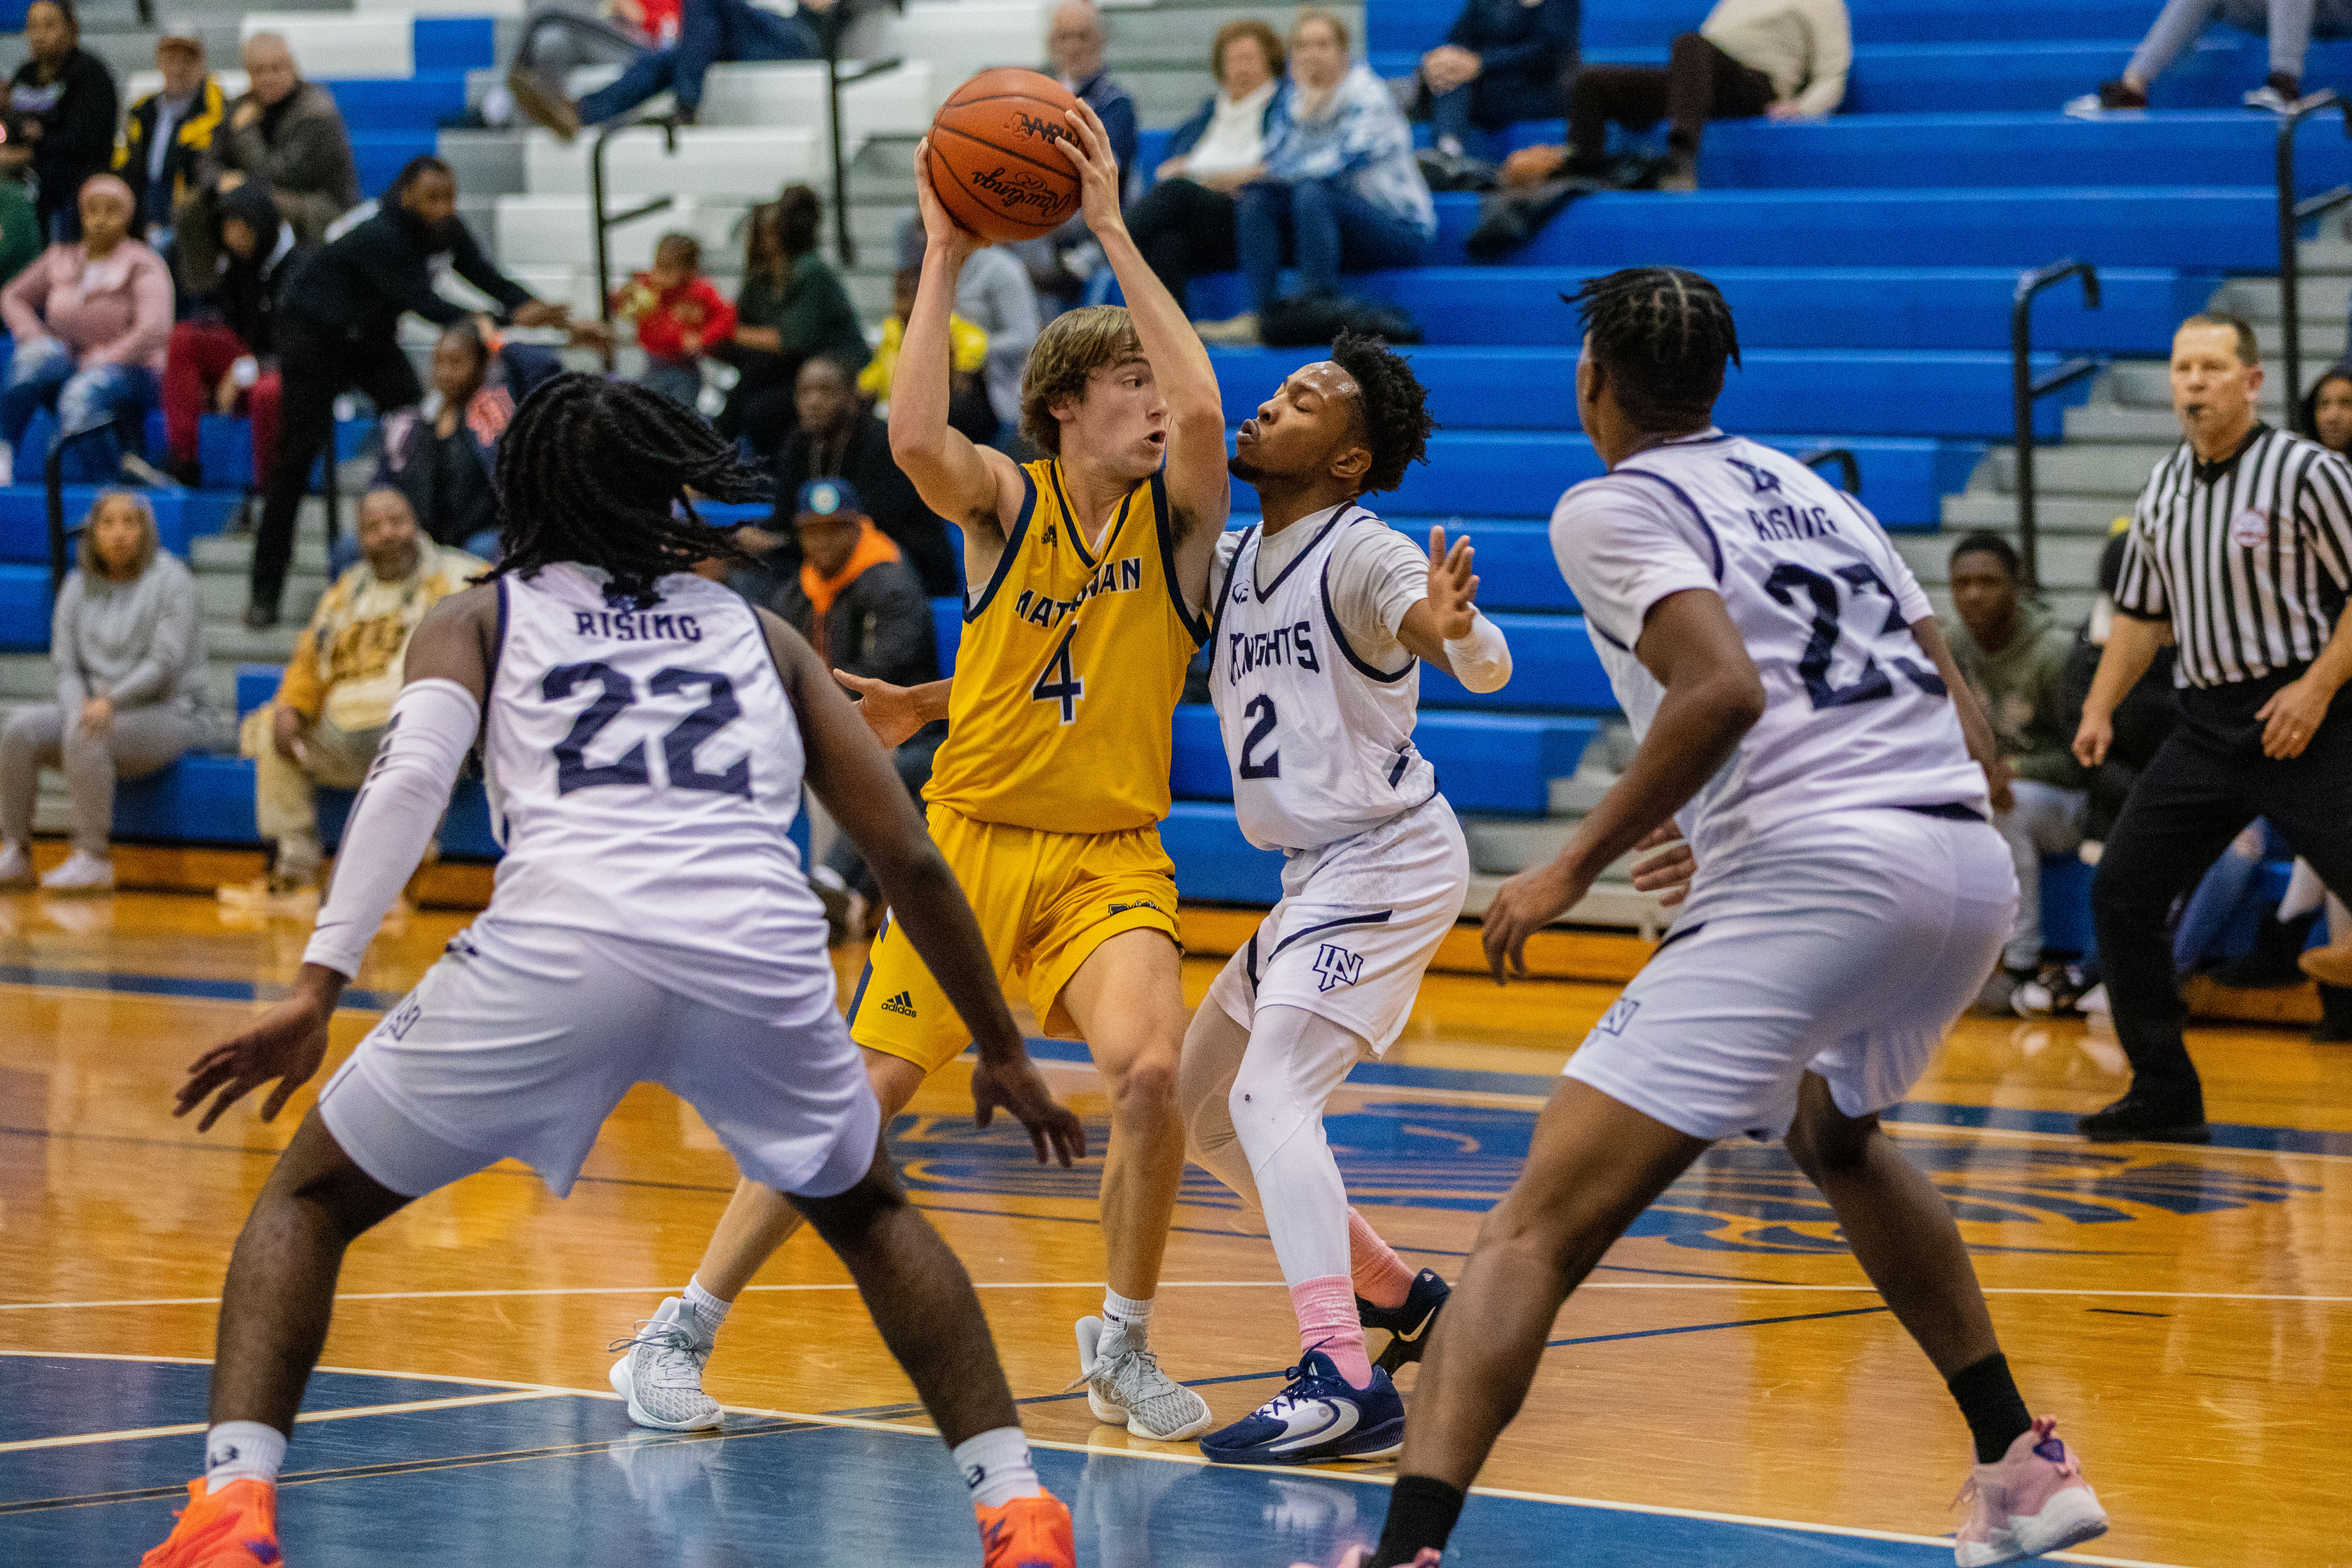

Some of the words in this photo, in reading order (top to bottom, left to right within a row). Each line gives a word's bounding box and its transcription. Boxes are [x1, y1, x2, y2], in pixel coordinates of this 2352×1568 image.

[972, 168, 1071, 217] Rawlings
[1747, 505, 1838, 541] RSIG
[573, 609, 702, 642] RISING
[1014, 556, 1142, 629] MATAN
[1230, 621, 1320, 686] KNGHTS
[1765, 563, 1947, 709] 23
[1030, 619, 1085, 725] 4
[542, 663, 753, 801] 22
[1239, 693, 1280, 779] 2
[881, 1003, 917, 1018] adidas
